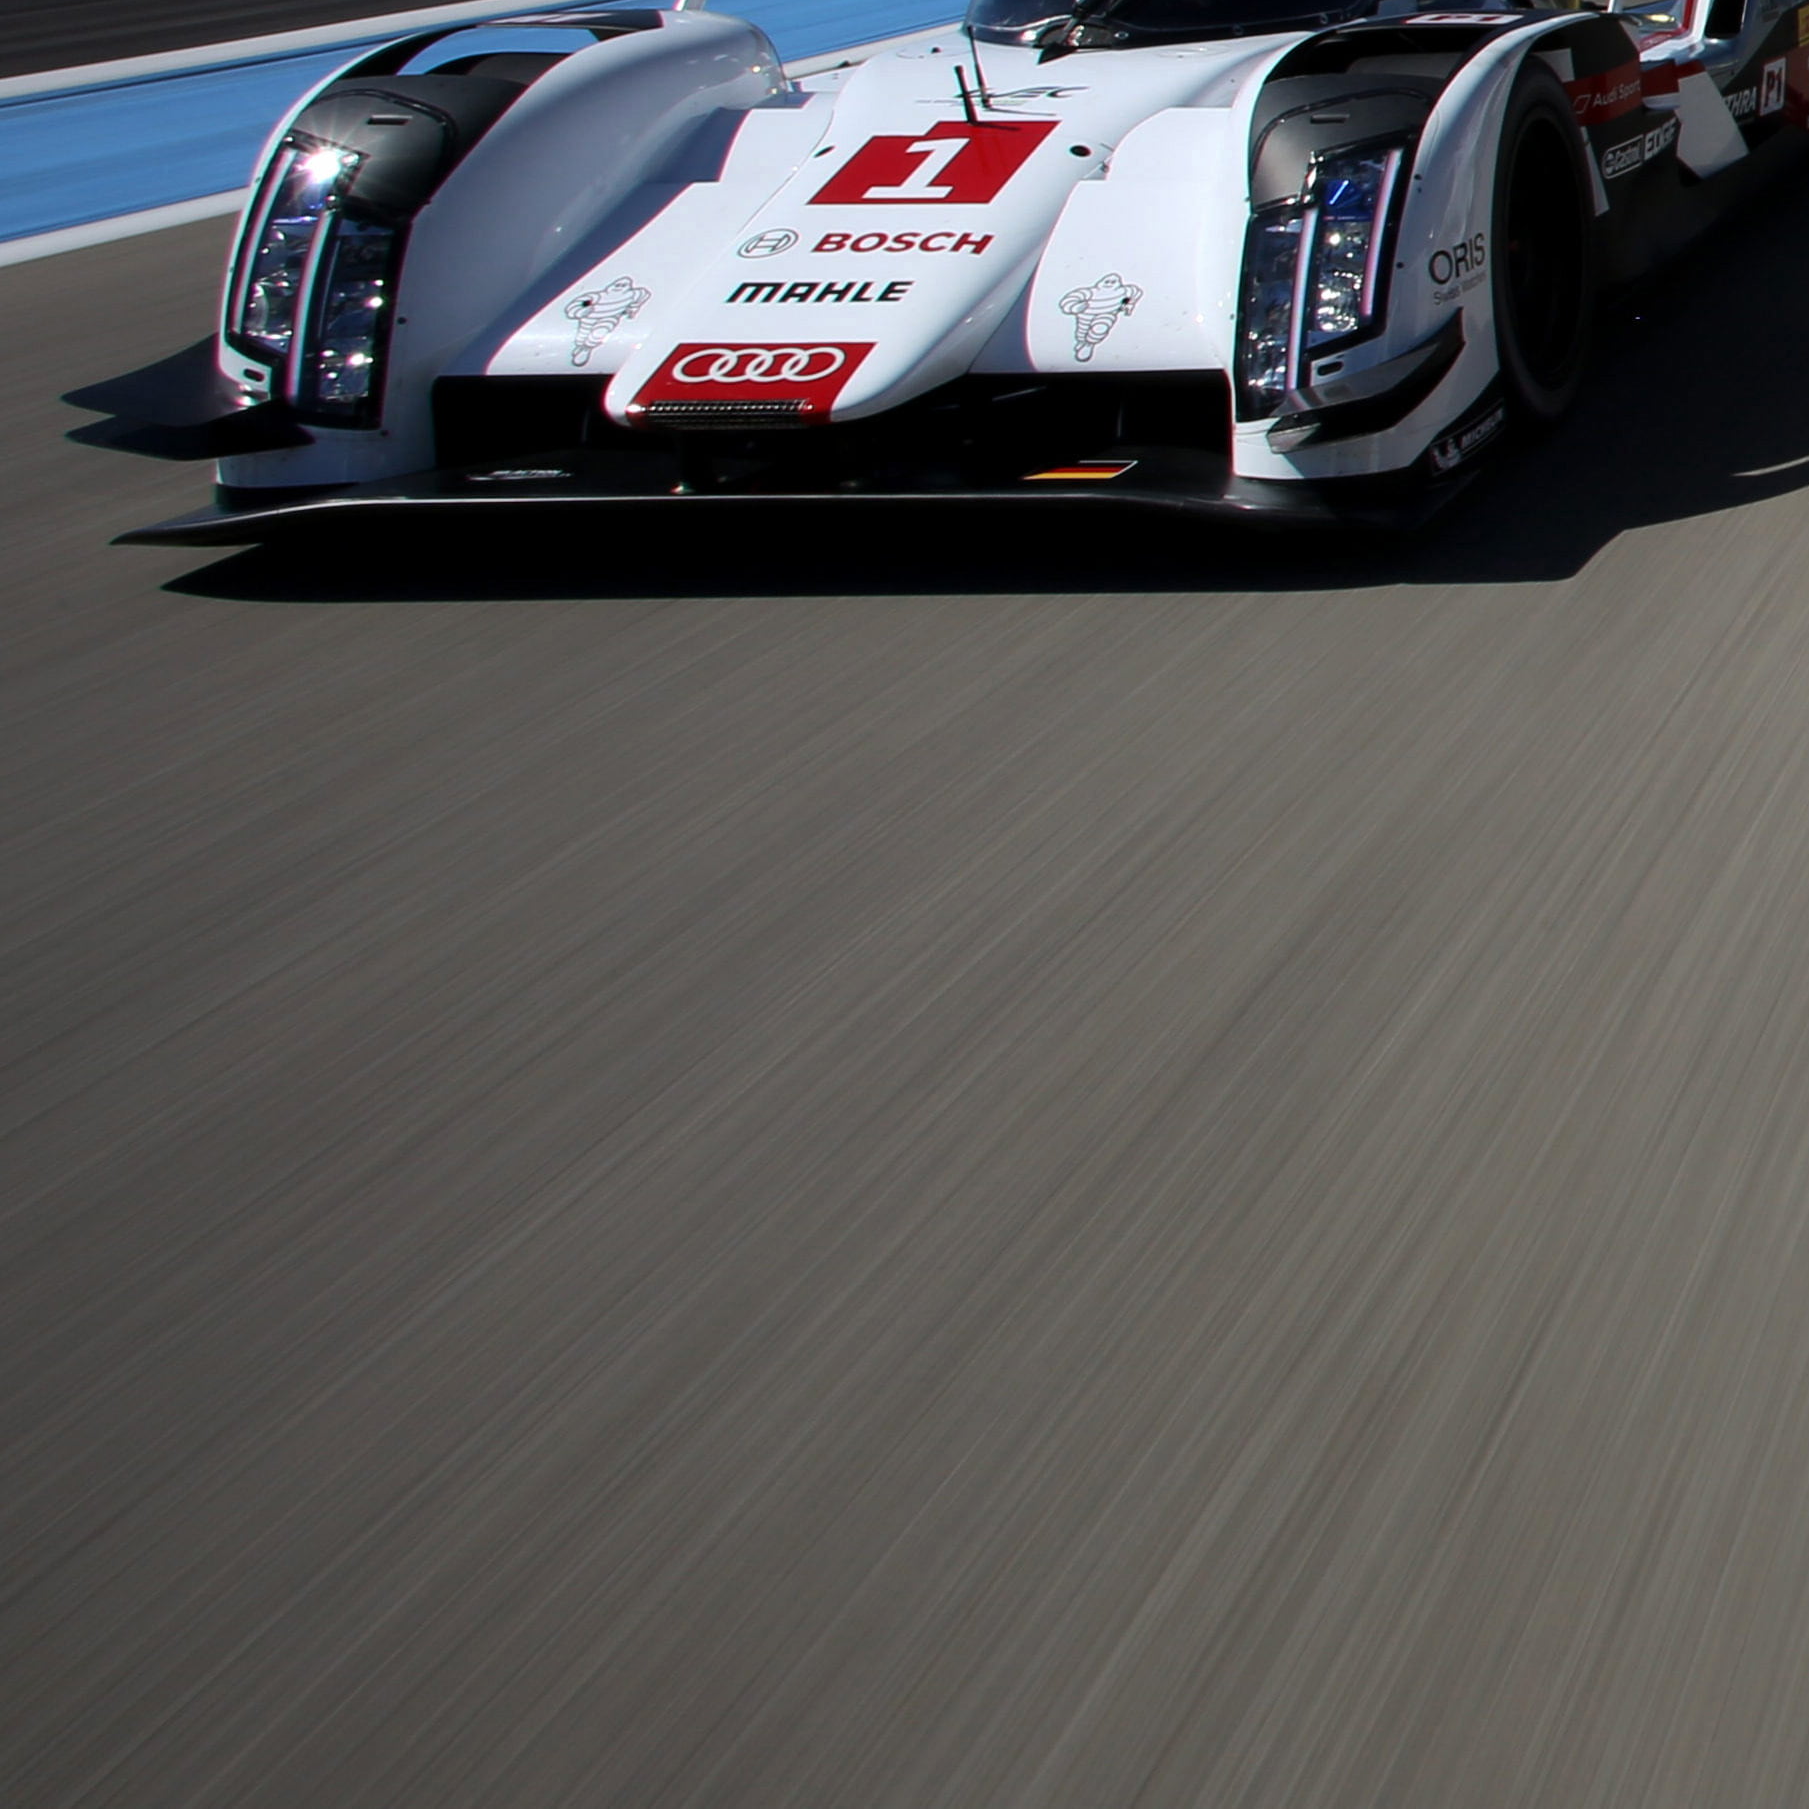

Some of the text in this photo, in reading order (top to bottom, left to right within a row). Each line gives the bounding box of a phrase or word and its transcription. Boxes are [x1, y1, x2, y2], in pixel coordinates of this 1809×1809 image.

[861, 137, 971, 200] 1
[810, 232, 995, 256] BOSCH
[1428, 232, 1486, 285] ORIS
[726, 281, 914, 303] MAHLE
